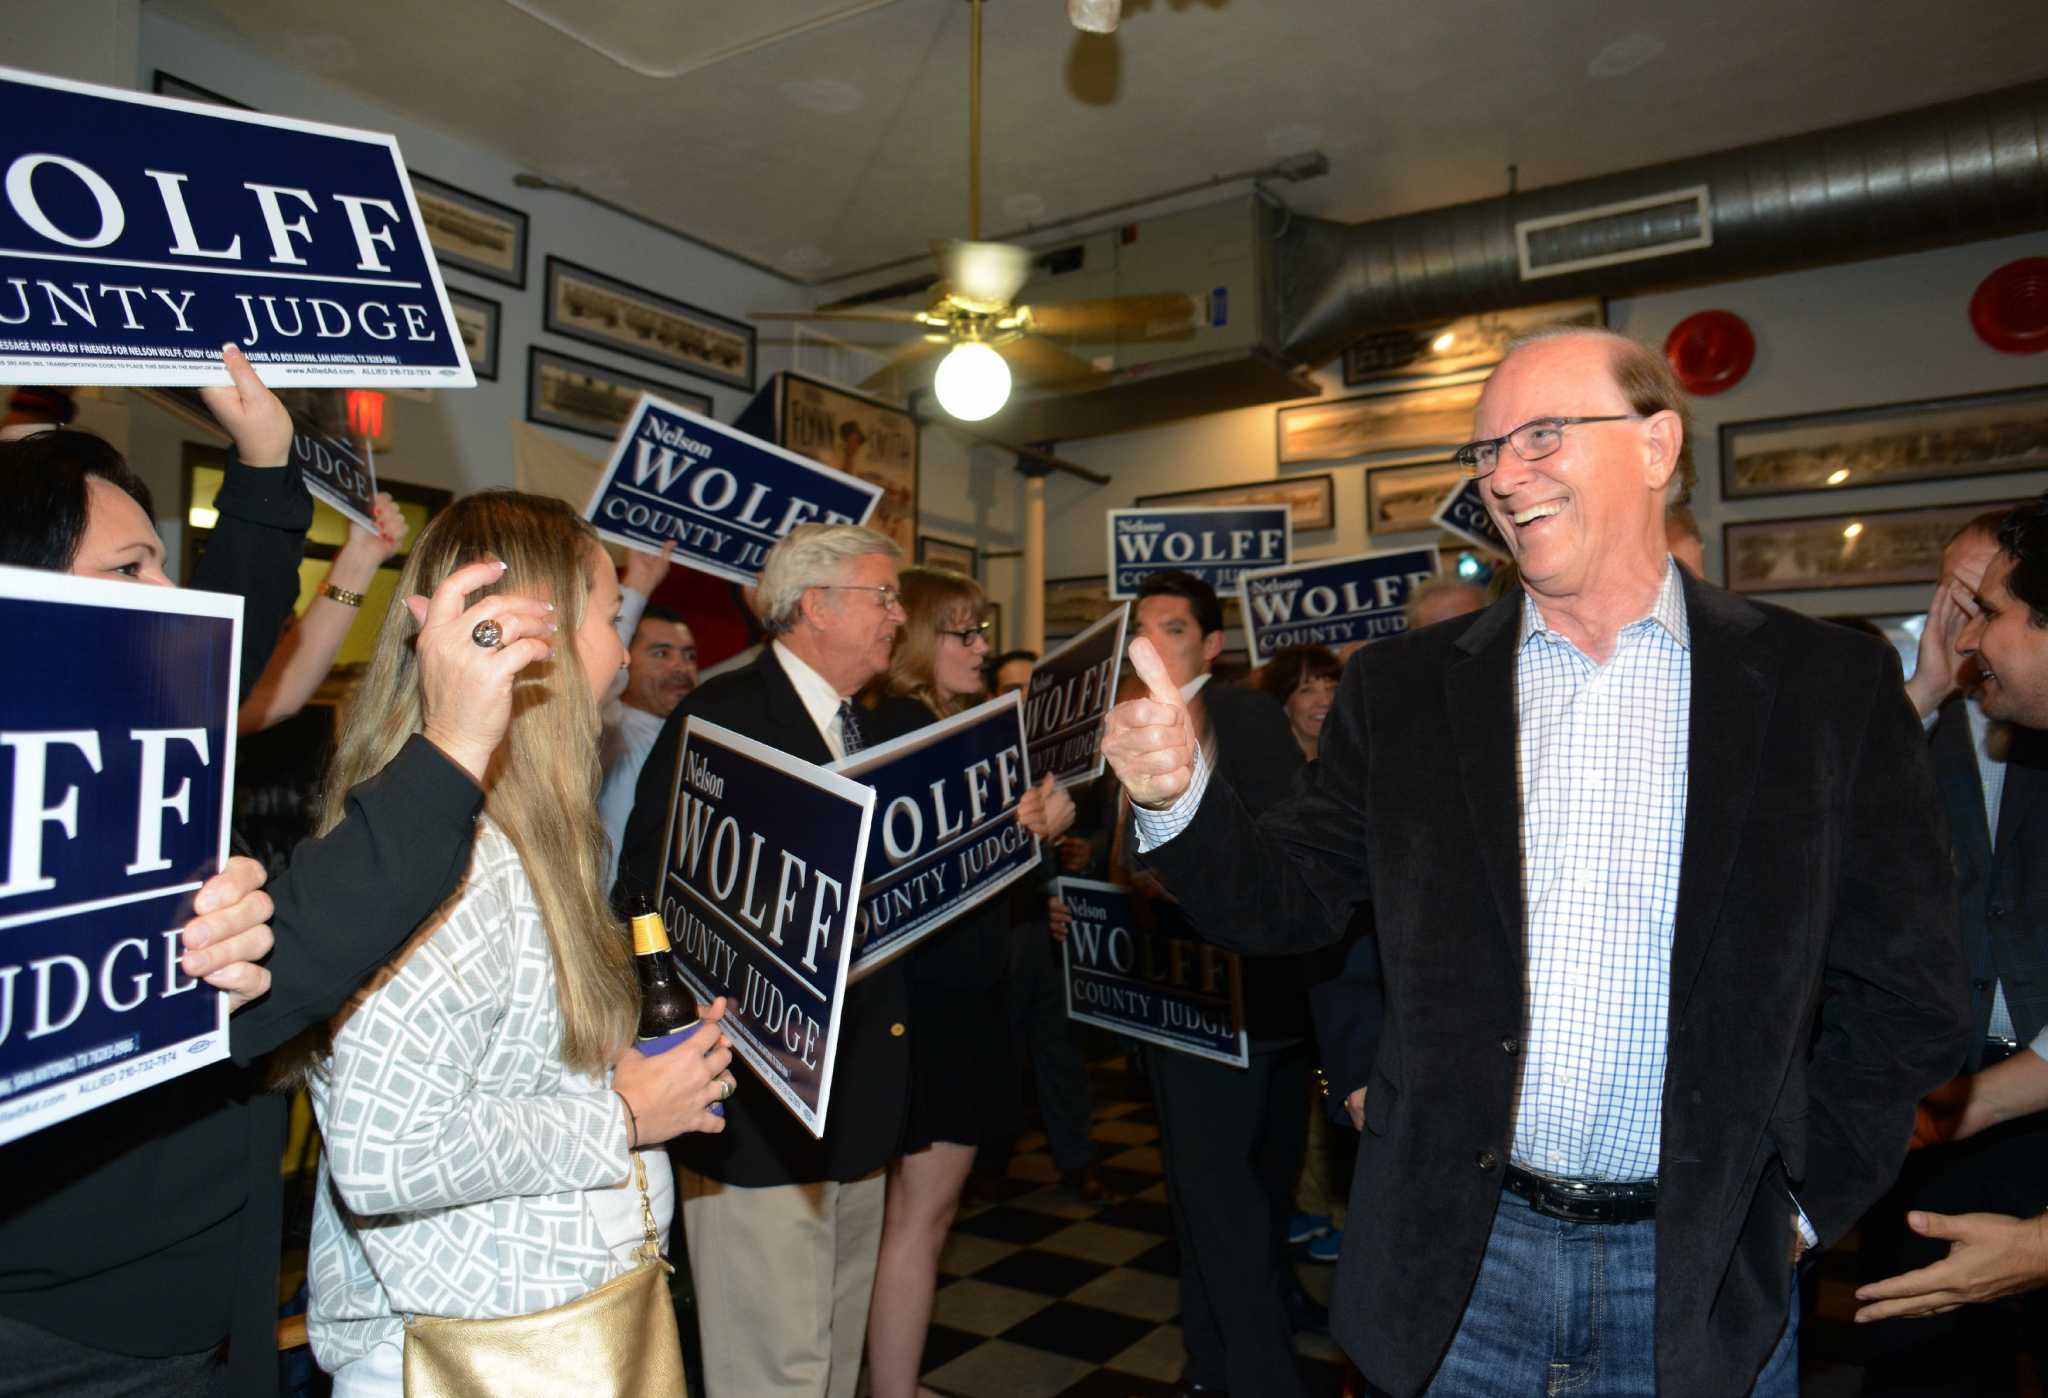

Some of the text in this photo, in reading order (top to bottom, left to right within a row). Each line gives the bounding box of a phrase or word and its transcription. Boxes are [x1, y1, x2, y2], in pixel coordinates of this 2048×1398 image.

[5, 153, 400, 273] OLFF
[0, 278, 437, 346] UNTY JUDGE
[31, 341, 51, 353] PAID
[51, 342, 69, 354] FOR
[69, 343, 80, 354] BY
[80, 343, 112, 356] FRIENDS
[113, 345, 128, 356] FOR
[128, 345, 158, 357] NELSON
[184, 349, 205, 360] CINDY
[294, 433, 370, 502] UDGE
[644, 414, 713, 460] Nelson
[604, 496, 733, 554] COUNTY
[1119, 530, 1284, 562] WOLFF
[1259, 614, 1409, 651] COUNTY JUD
[685, 749, 725, 800] Nelson
[877, 744, 1021, 860] OLFF
[676, 791, 843, 974] WOLFF
[959, 820, 1030, 889] JUDGE
[1067, 896, 1108, 921] Nelson
[664, 896, 738, 989] COUNTY
[739, 963, 820, 1071] JUDGE
[1074, 978, 1152, 1018] COUNTY
[1160, 999, 1234, 1039] JUDGE
